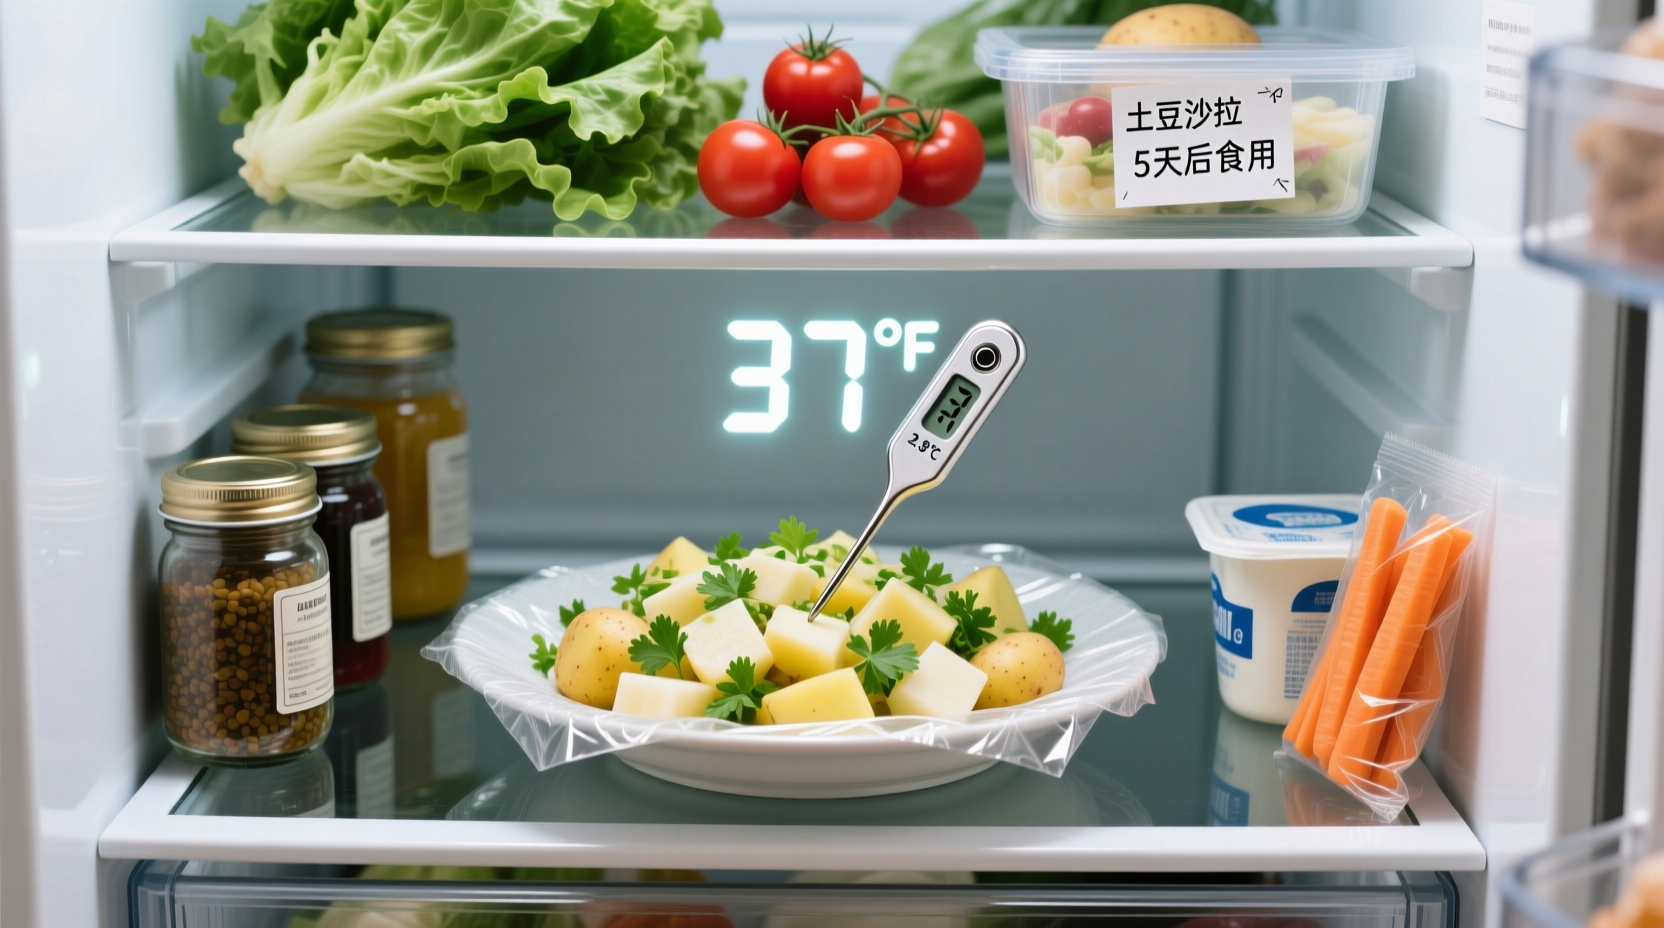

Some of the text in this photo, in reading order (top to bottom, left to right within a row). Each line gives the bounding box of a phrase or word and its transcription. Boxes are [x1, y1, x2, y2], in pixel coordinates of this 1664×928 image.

[1126, 96, 1243, 132] 土豆沙拉
[1134, 139, 1275, 179] 5天后食用
[722, 317, 940, 433] 37°F
